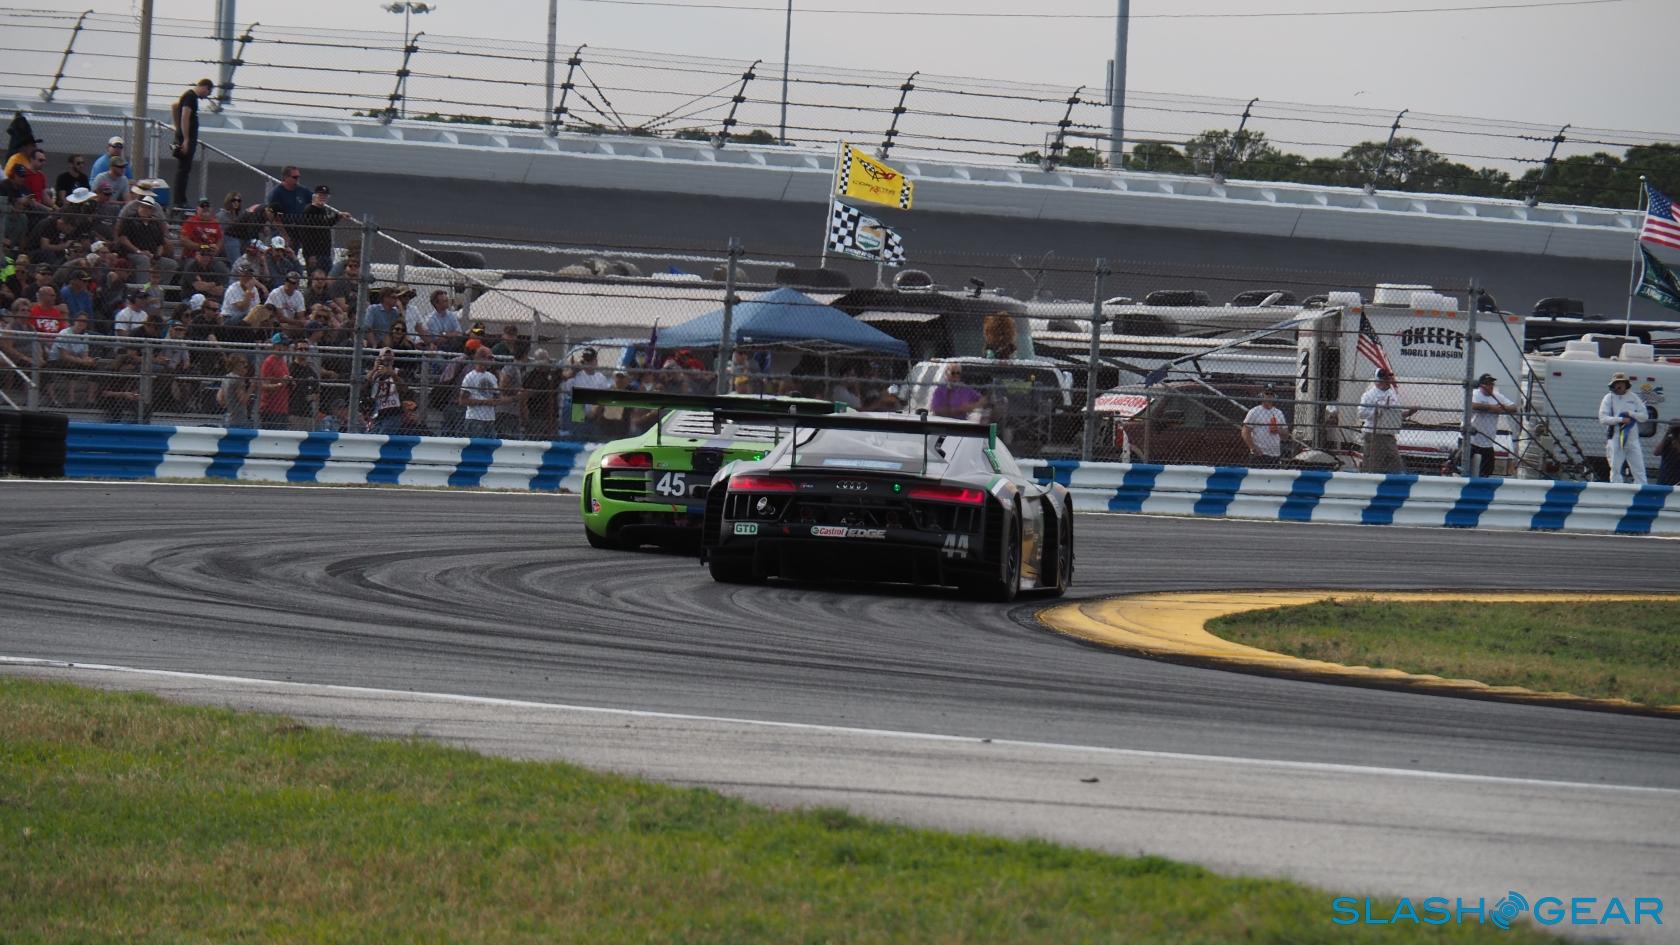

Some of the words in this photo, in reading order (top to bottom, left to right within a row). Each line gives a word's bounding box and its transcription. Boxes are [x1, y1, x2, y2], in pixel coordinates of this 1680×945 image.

[1400, 348, 1428, 357] MOBILE
[1430, 350, 1464, 359] MANSION
[656, 472, 686, 496] 45
[736, 524, 757, 534] GTD
[819, 527, 845, 536] Castrol
[847, 528, 887, 539] EDGE
[942, 534, 969, 558] 44
